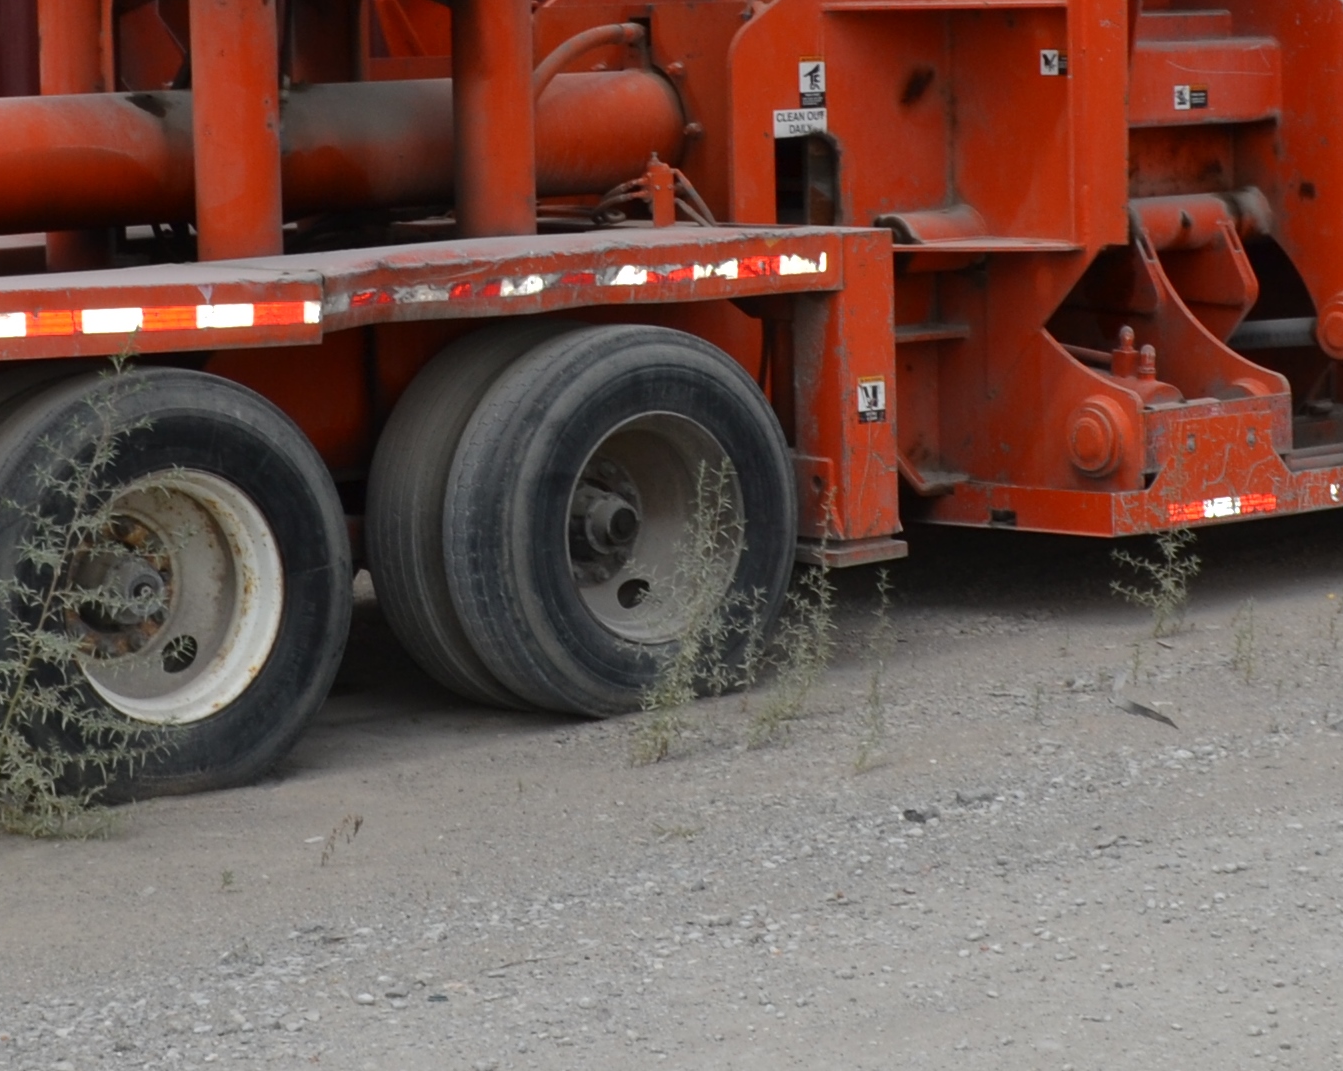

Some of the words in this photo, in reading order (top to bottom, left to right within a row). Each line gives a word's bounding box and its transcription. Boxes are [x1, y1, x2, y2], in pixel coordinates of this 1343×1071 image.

[776, 112, 805, 123] CLEAN
[807, 110, 825, 121] OUT
[789, 124, 813, 134] DAILY
